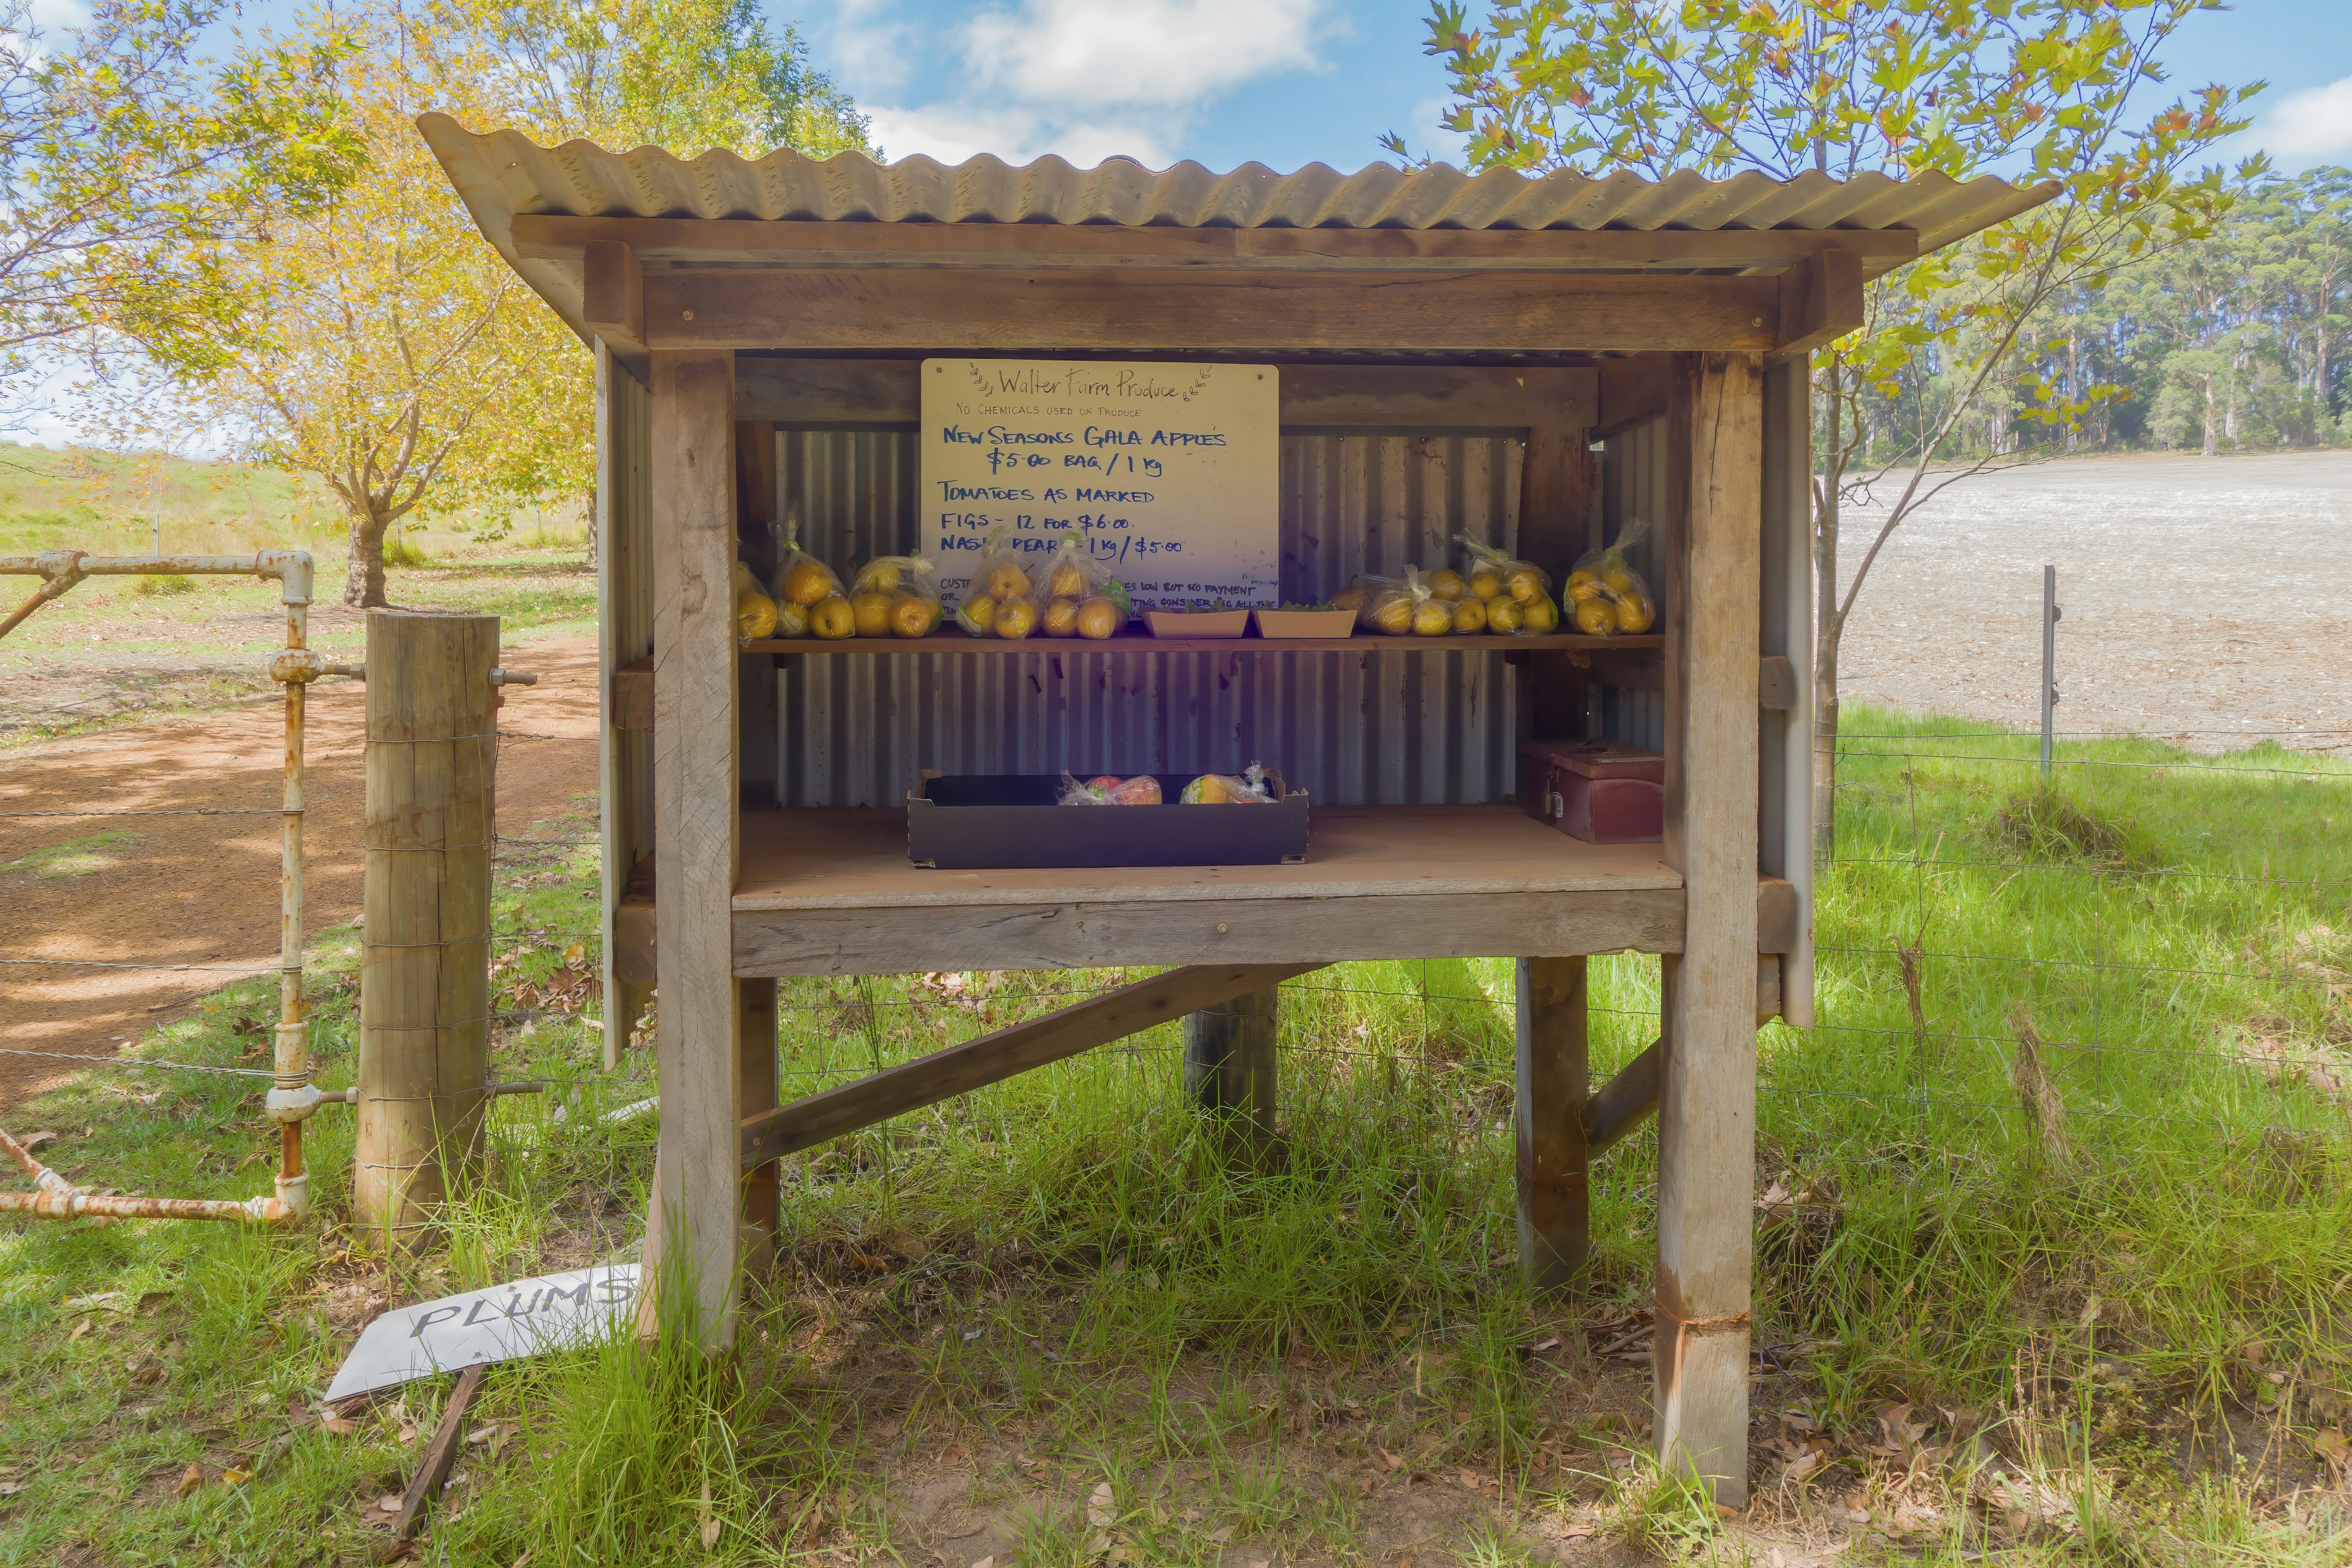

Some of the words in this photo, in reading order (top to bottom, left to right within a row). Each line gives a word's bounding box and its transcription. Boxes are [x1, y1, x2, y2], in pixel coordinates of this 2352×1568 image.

[999, 369, 1062, 395] Walter
[1066, 368, 1110, 396] Farm
[1116, 370, 1179, 398] Produce
[978, 404, 1039, 415] CHEMICALS
[1047, 407, 1072, 415] USED
[1080, 408, 1092, 416] ON
[1098, 407, 1142, 417] PRODUCE
[943, 425, 984, 444] NEW
[987, 426, 1074, 444] SEASONS
[1084, 426, 1143, 448] GALA
[1151, 430, 1227, 446] APPLES
[1064, 455, 1101, 470] BAG
[1128, 456, 1133, 472] 1
[937, 480, 1035, 502] TOMATOES
[1044, 488, 1067, 503] AS
[1076, 488, 1154, 502] MARKED
[1017, 514, 1035, 530] 12
[1044, 518, 1072, 530] FOR
[1012, 538, 1057, 554] PEAR
[940, 592, 960, 601] OR
[1163, 582, 1185, 592] BUT
[1188, 583, 1201, 592] NO
[1205, 584, 1256, 596] PAYMENT
[409, 1276, 638, 1338] PLUMS
